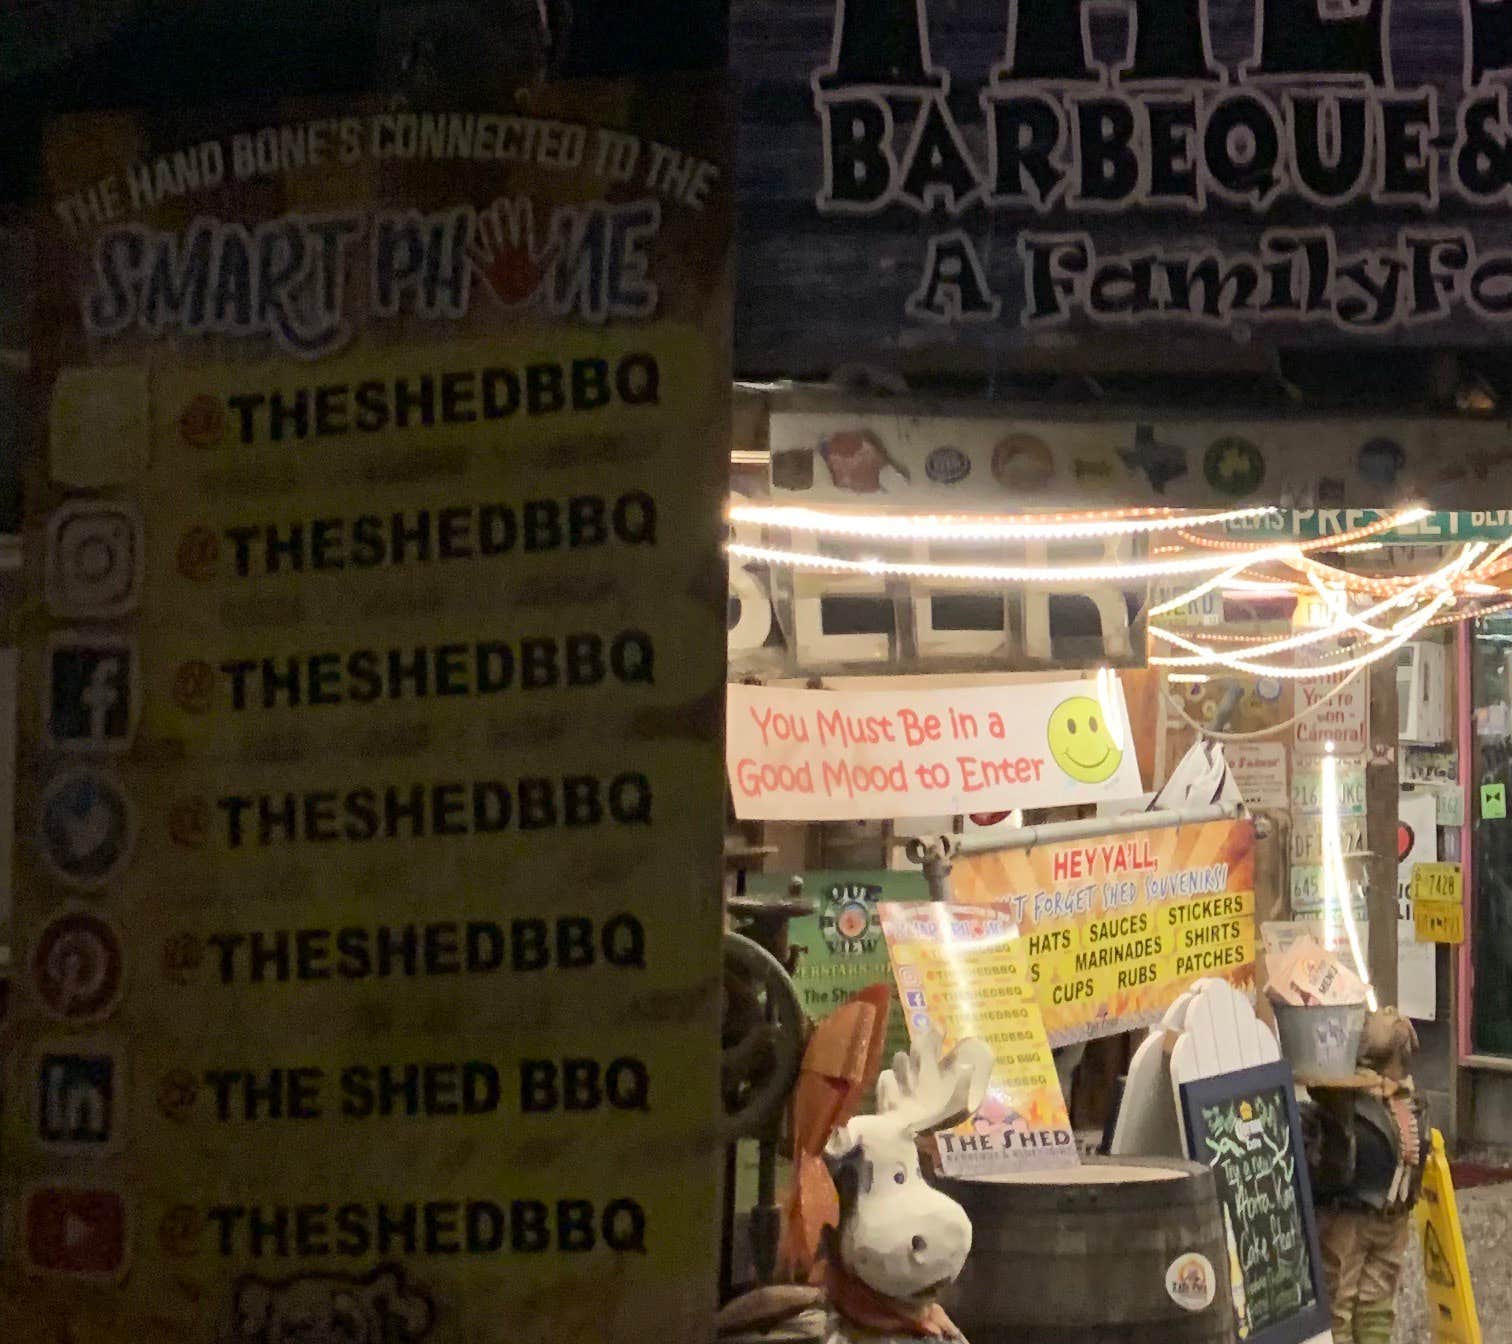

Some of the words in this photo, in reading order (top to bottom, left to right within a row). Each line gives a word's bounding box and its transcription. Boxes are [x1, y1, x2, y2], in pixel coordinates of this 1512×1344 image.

[125, 139, 224, 209] HAND
[369, 112, 588, 170] CONNECTED
[594, 127, 644, 183] TO
[646, 139, 720, 211] THE
[82, 210, 366, 362] SMART
[374, 194, 663, 324] PHNE
[907, 232, 999, 321] A
[750, 705, 808, 747] You
[816, 709, 895, 748] Must
[897, 707, 942, 747] Be
[988, 709, 1006, 740] a
[737, 757, 814, 797] Good
[822, 752, 909, 798] Mood
[915, 763, 950, 792] to
[956, 756, 1045, 793] Enter
[1053, 848, 1096, 881] HEY
[1028, 929, 1073, 957] HATS
[1089, 912, 1149, 944] SAUCES
[1167, 895, 1244, 926] STICKERS
[1033, 884, 1098, 925] FORGET
[1102, 880, 1137, 913] SHED
[1074, 935, 1163, 973] MARINADES
[1184, 921, 1242, 949] SHIRTS
[1051, 978, 1095, 1006] CUPS
[1117, 963, 1158, 989] RUBS
[1175, 945, 1246, 976] PATCHES
[338, 1057, 501, 1121] SHED
[519, 1057, 652, 1115] BBQ
[937, 1131, 993, 1154] THE
[1002, 1128, 1071, 1154] SHED
